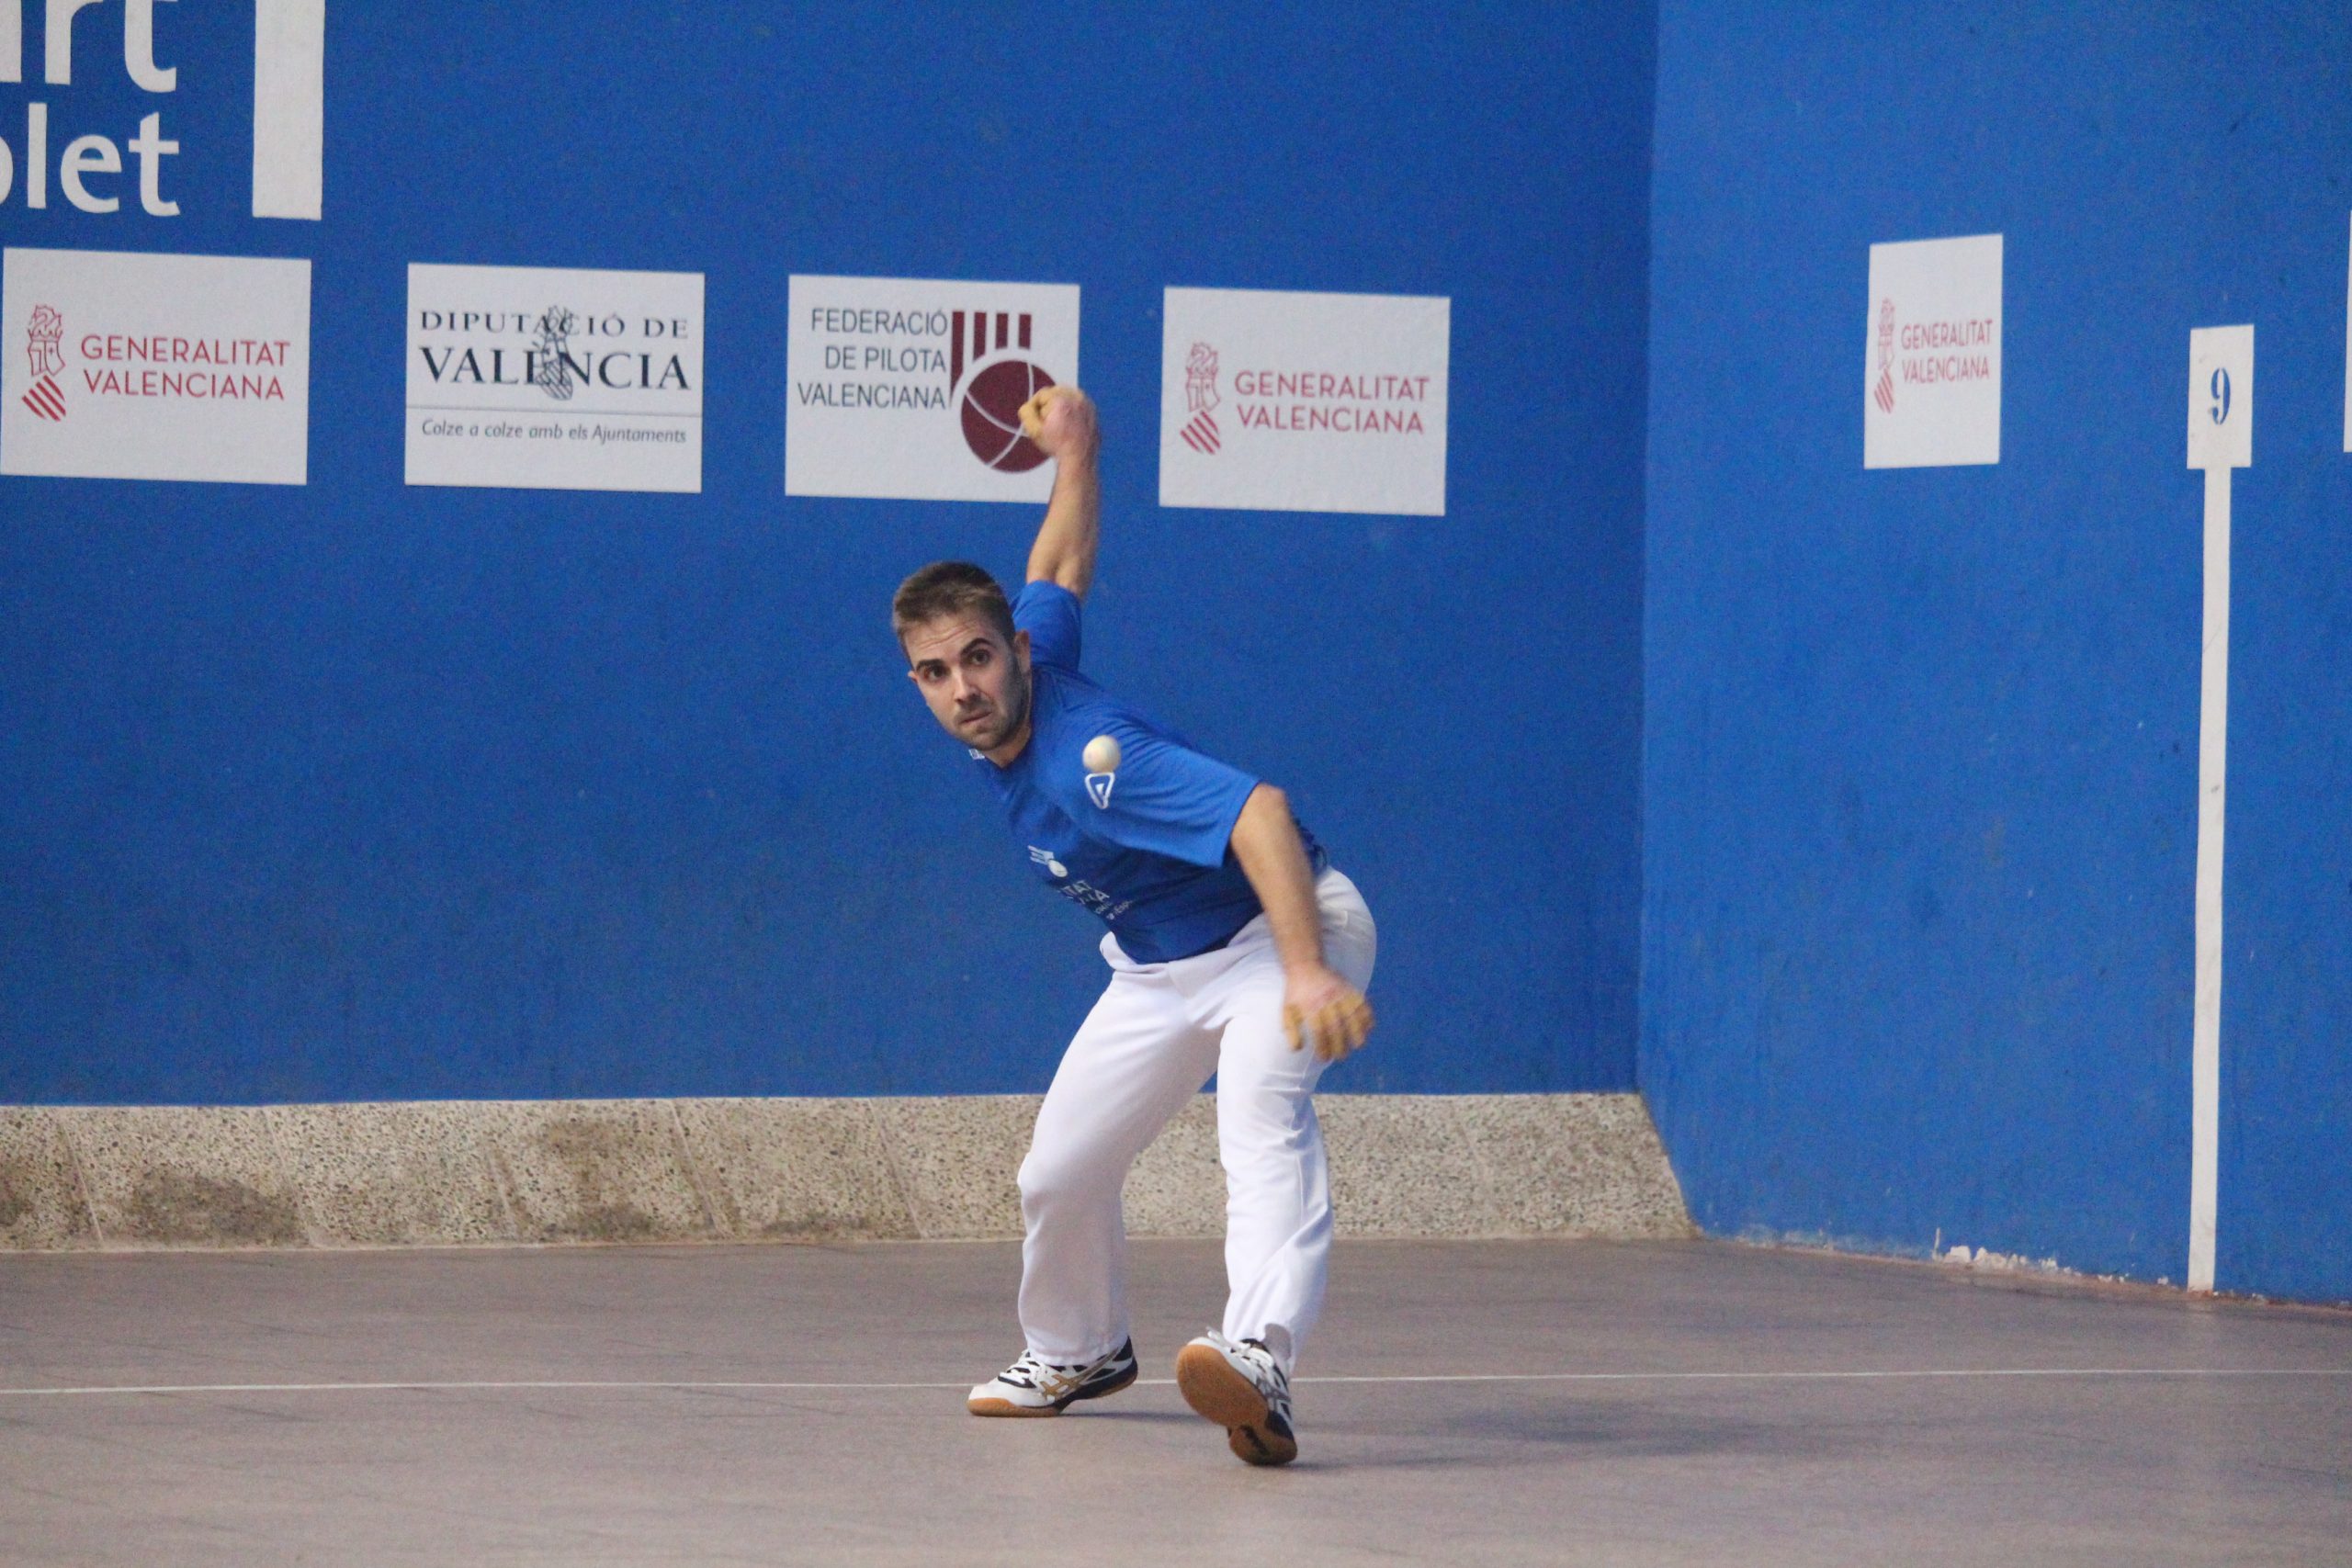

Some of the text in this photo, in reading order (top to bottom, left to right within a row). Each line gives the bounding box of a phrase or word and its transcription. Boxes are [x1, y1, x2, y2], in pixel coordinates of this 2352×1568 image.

[0, 0, 177, 93] rt
[0, 102, 181, 217] let
[420, 309, 689, 339] DIPUTACIÓ DE
[811, 307, 949, 336] FEDERACIÓ
[1901, 319, 1993, 350] GENERALITAT
[80, 334, 291, 367] GENERALITAT
[824, 345, 947, 373] DE PILOTA
[83, 369, 285, 400] VALENCIANA
[1902, 355, 1990, 384] VALENCIANA
[797, 382, 946, 410] VALENCIANA
[1234, 370, 1430, 402] GENERALITAT
[2211, 367, 2231, 425] 9
[422, 418, 687, 446] Colze a colze amb els Ajuntaments
[1237, 404, 1423, 434] VALENCIANA
